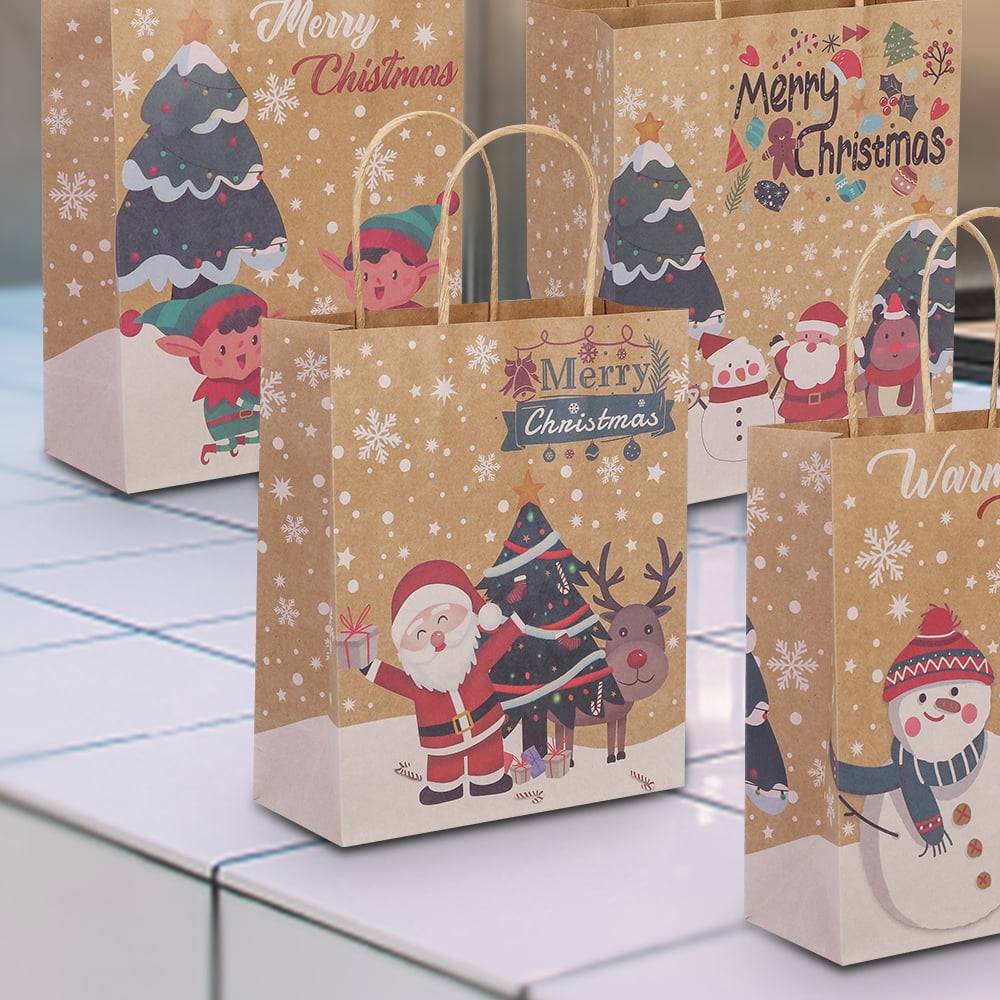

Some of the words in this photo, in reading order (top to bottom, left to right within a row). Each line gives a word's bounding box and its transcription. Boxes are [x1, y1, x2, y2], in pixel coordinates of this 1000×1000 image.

[291, 49, 458, 96] Chistmas
[734, 67, 840, 126] Merry
[794, 125, 946, 177] Christmas
[540, 357, 651, 392] Merry
[524, 407, 659, 436] Christmas
